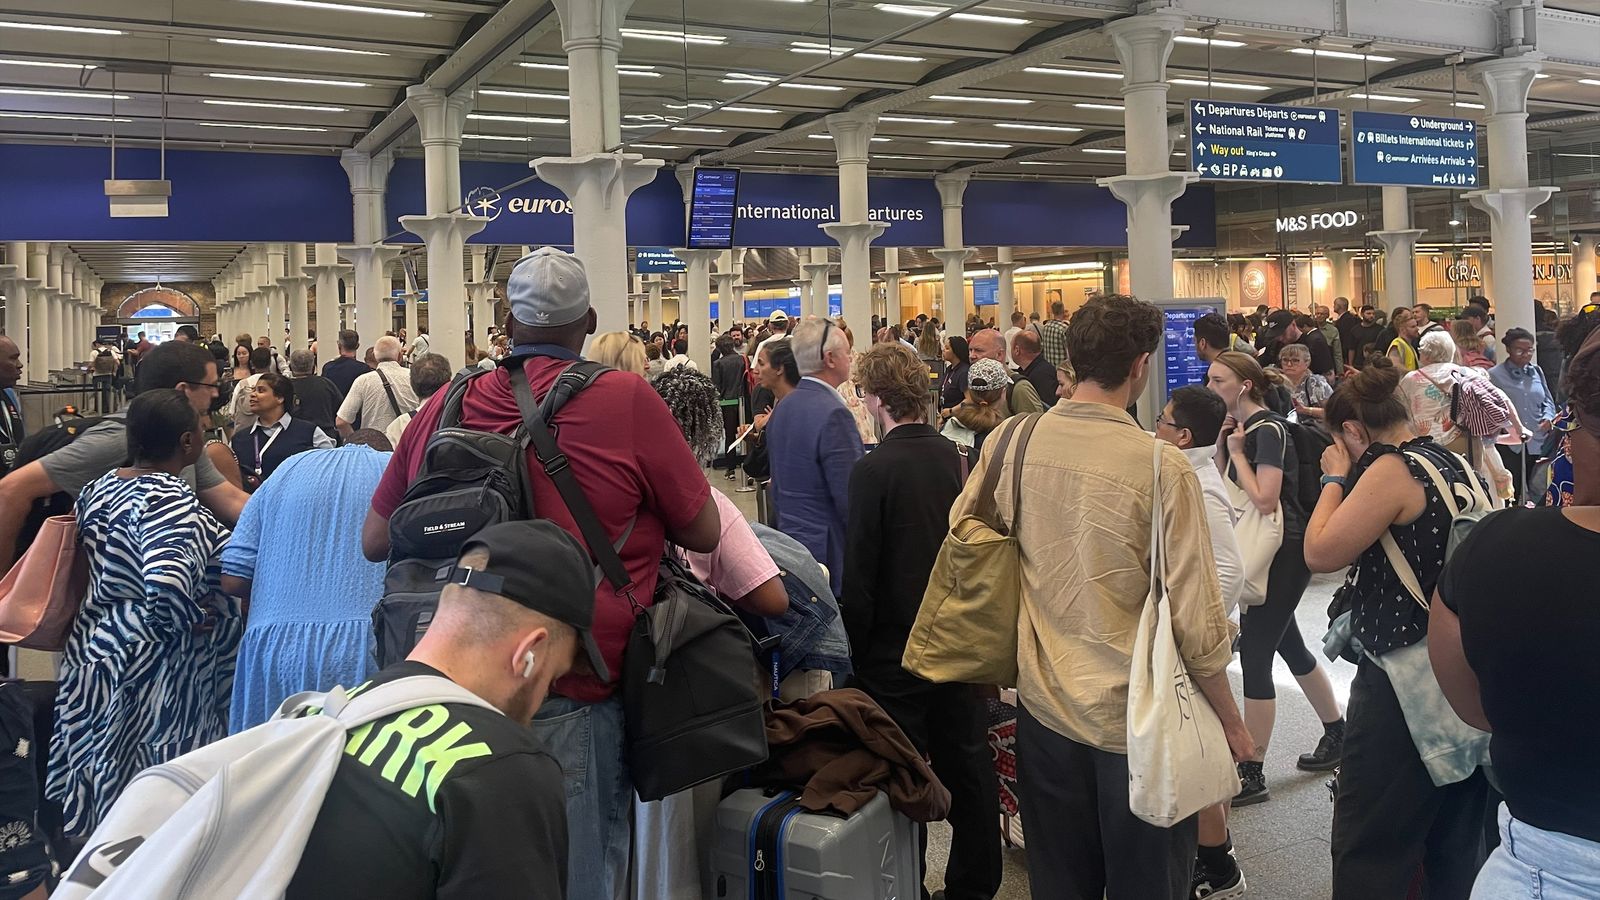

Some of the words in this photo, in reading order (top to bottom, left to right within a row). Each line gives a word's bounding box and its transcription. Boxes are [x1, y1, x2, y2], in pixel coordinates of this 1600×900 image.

[1208, 103, 1255, 117] Departures
[1256, 107, 1288, 120] Départs
[1209, 124, 1245, 136] National
[1246, 126, 1263, 137] Rail
[1420, 118, 1464, 131] Underground
[1375, 133, 1398, 144] Billets
[1399, 135, 1442, 146] International
[1443, 138, 1465, 148] tickets
[1210, 144, 1229, 157] Way
[1230, 146, 1244, 156] out
[1410, 154, 1439, 164] Arrivées
[1439, 155, 1466, 166] Arrivals
[508, 197, 574, 214] euros
[737, 204, 836, 220] nternational
[868, 206, 923, 221] artures
[1276, 215, 1307, 233] M&S
[1310, 210, 1358, 230] FOOD
[1448, 265, 1480, 281] GRA
[444, 521, 466, 529] STREAM
